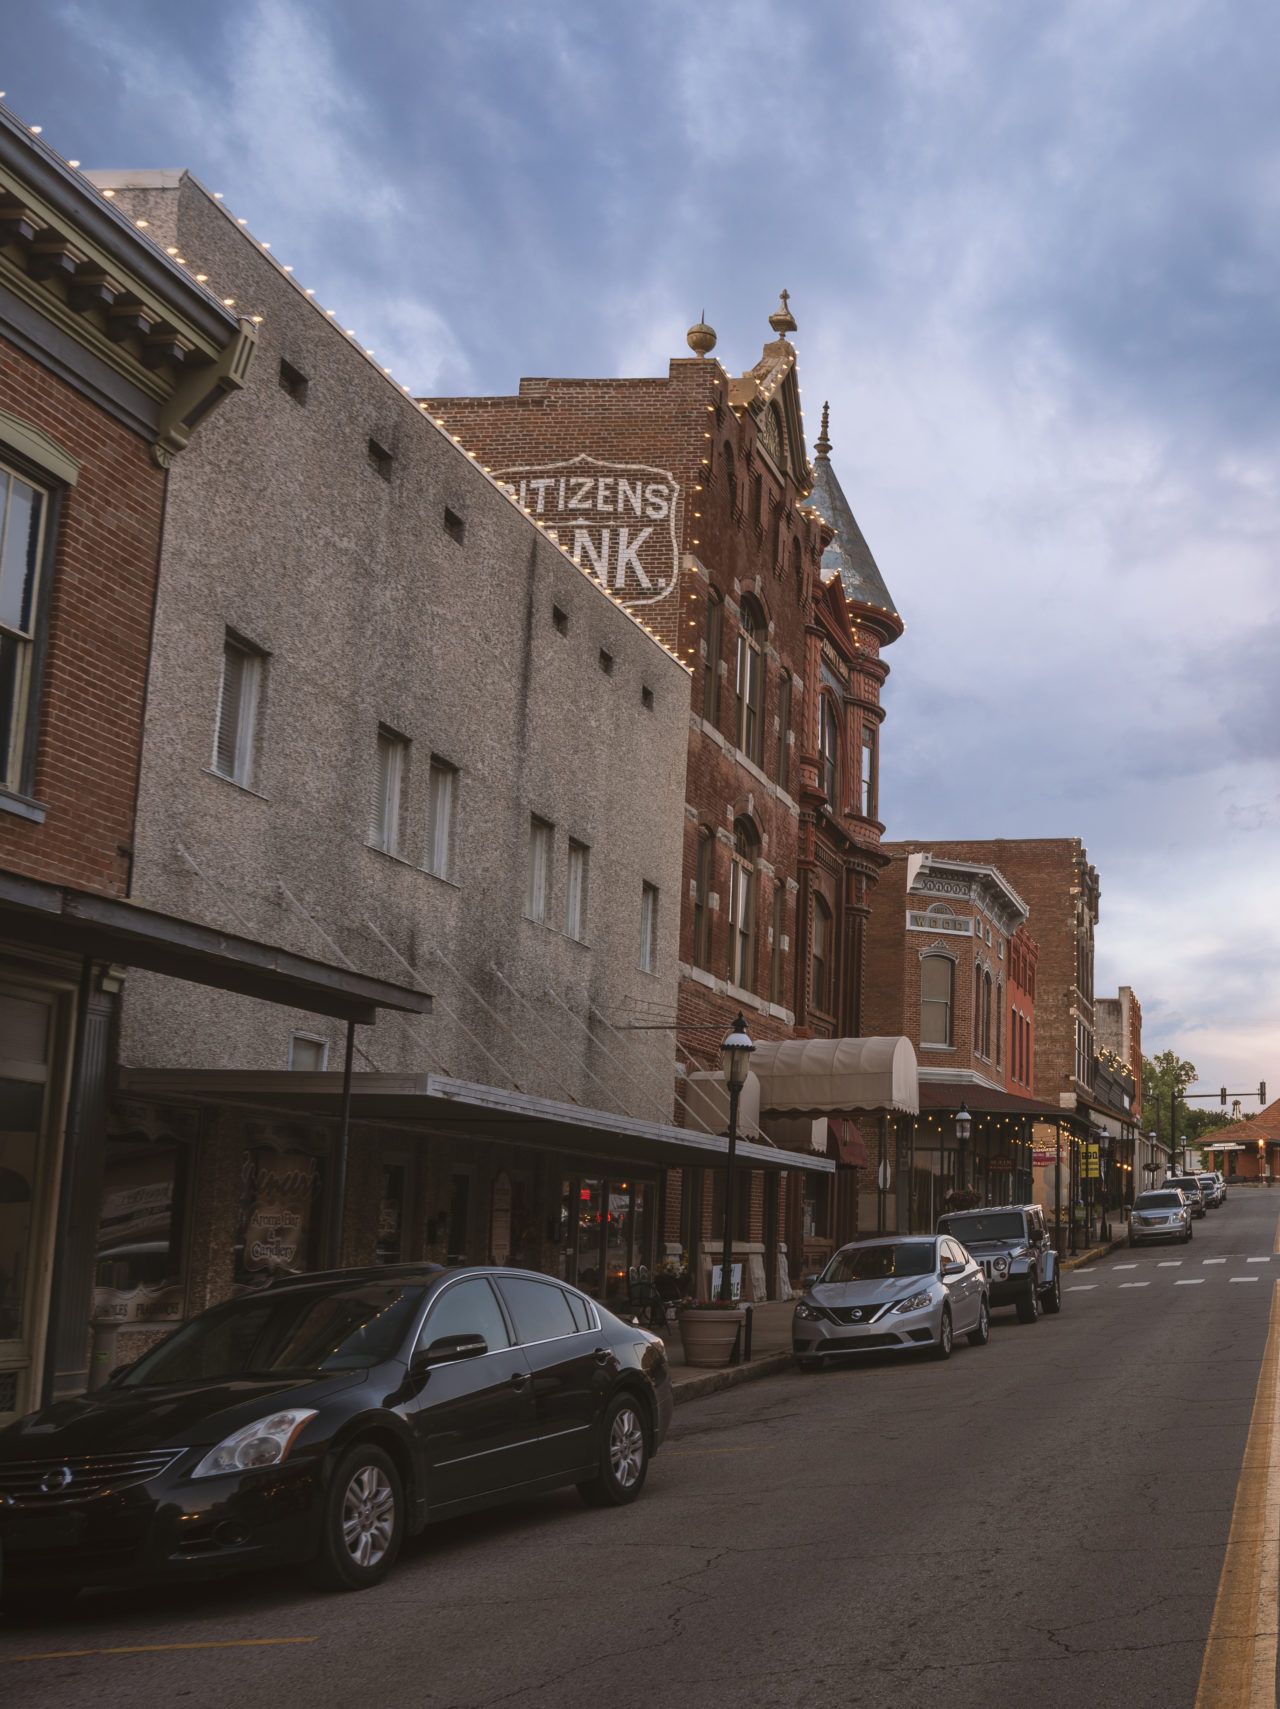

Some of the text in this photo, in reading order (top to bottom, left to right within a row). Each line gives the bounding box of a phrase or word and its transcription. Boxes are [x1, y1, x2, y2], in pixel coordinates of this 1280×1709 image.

[548, 528, 667, 588] NK.
[916, 916, 963, 931] WOOD
[284, 1212, 300, 1226] Bar
